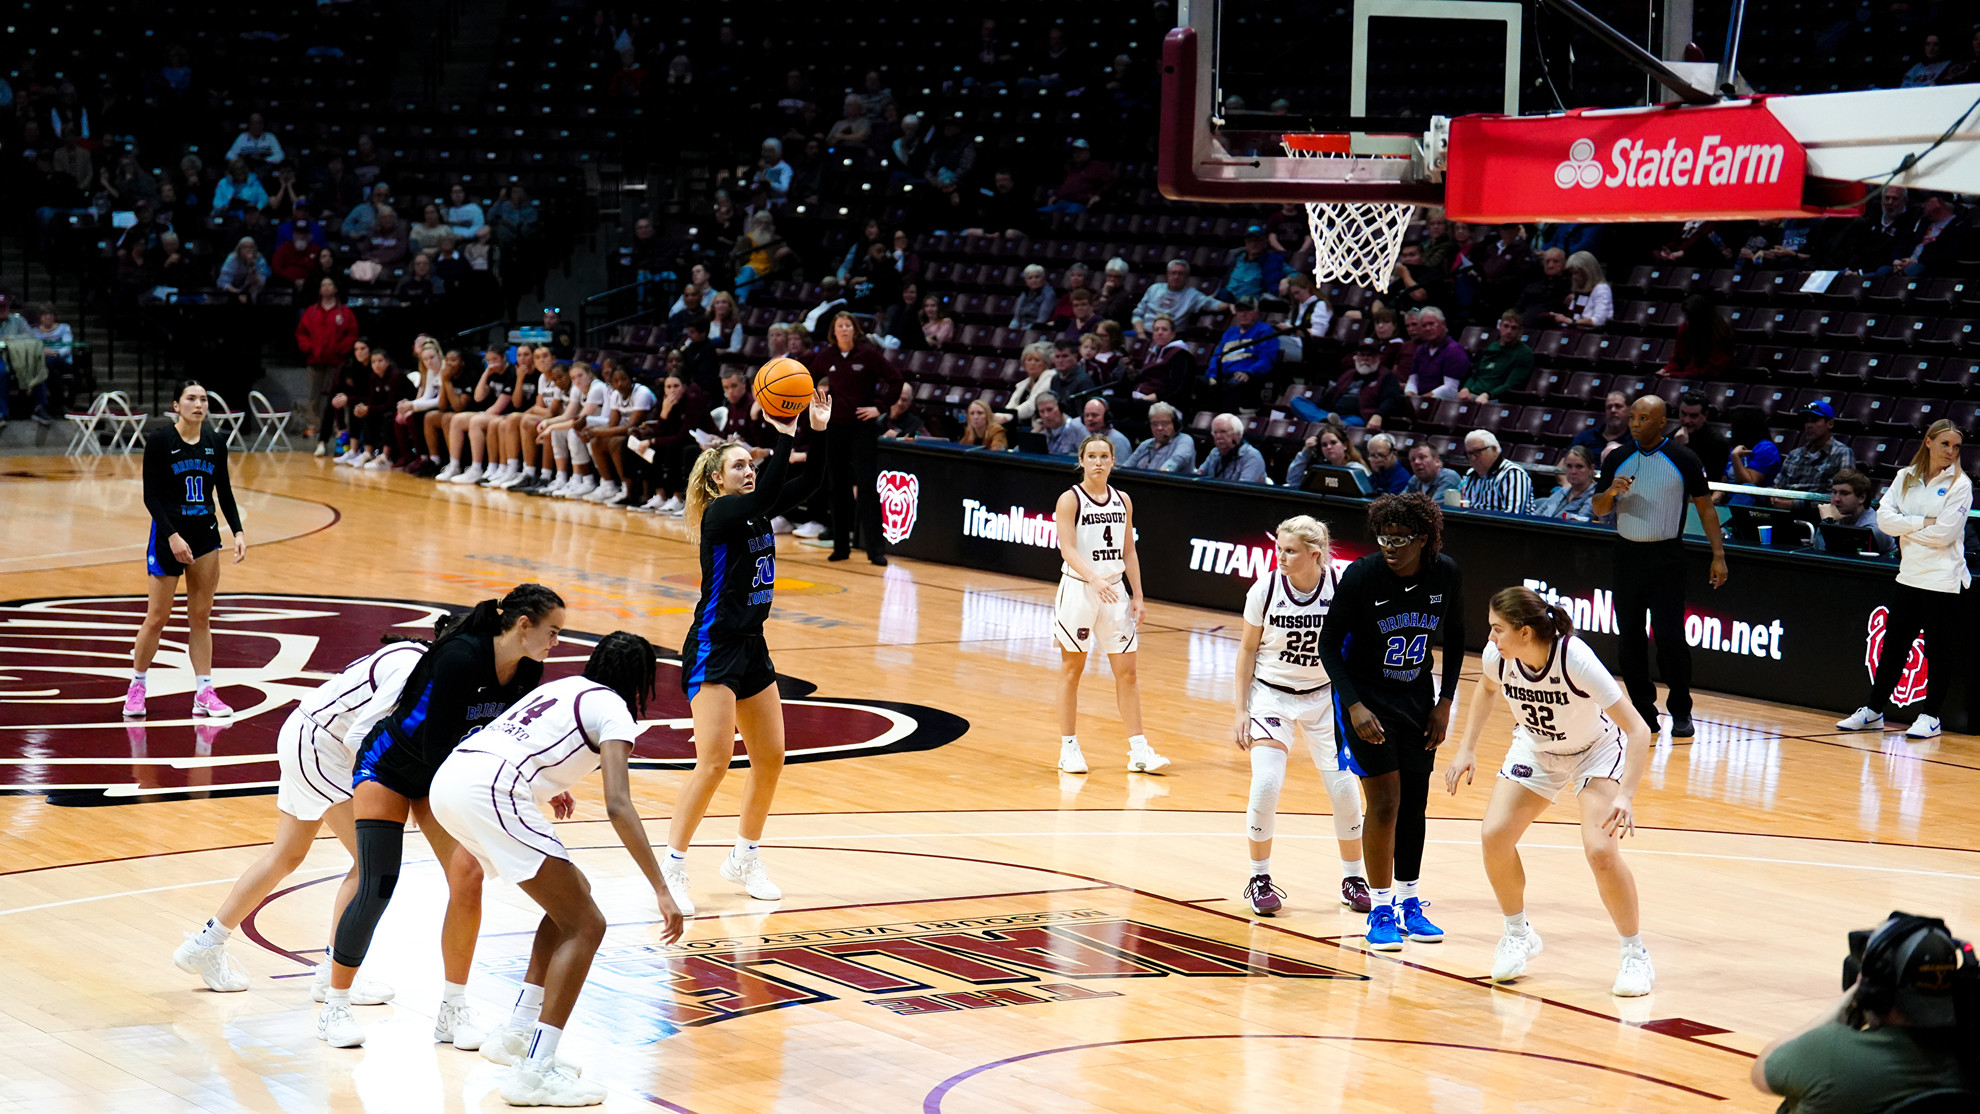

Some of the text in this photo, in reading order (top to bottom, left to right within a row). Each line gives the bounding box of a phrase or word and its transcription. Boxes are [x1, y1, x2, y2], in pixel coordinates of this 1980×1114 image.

[171, 459, 215, 475] BRIGHAM
[185, 476, 204, 502] 11
[1103, 525, 1113, 547] 4
[1190, 537, 1274, 579] TITAN
[752, 553, 776, 588] 30
[1377, 612, 1440, 634] BRIGHAM
[1286, 630, 1318, 653] 22
[1384, 634, 1428, 667] 24
[1278, 650, 1320, 667] STATE
[1503, 683, 1570, 706] MISSOURI
[507, 695, 558, 726] 14
[1521, 703, 1556, 731] 32
